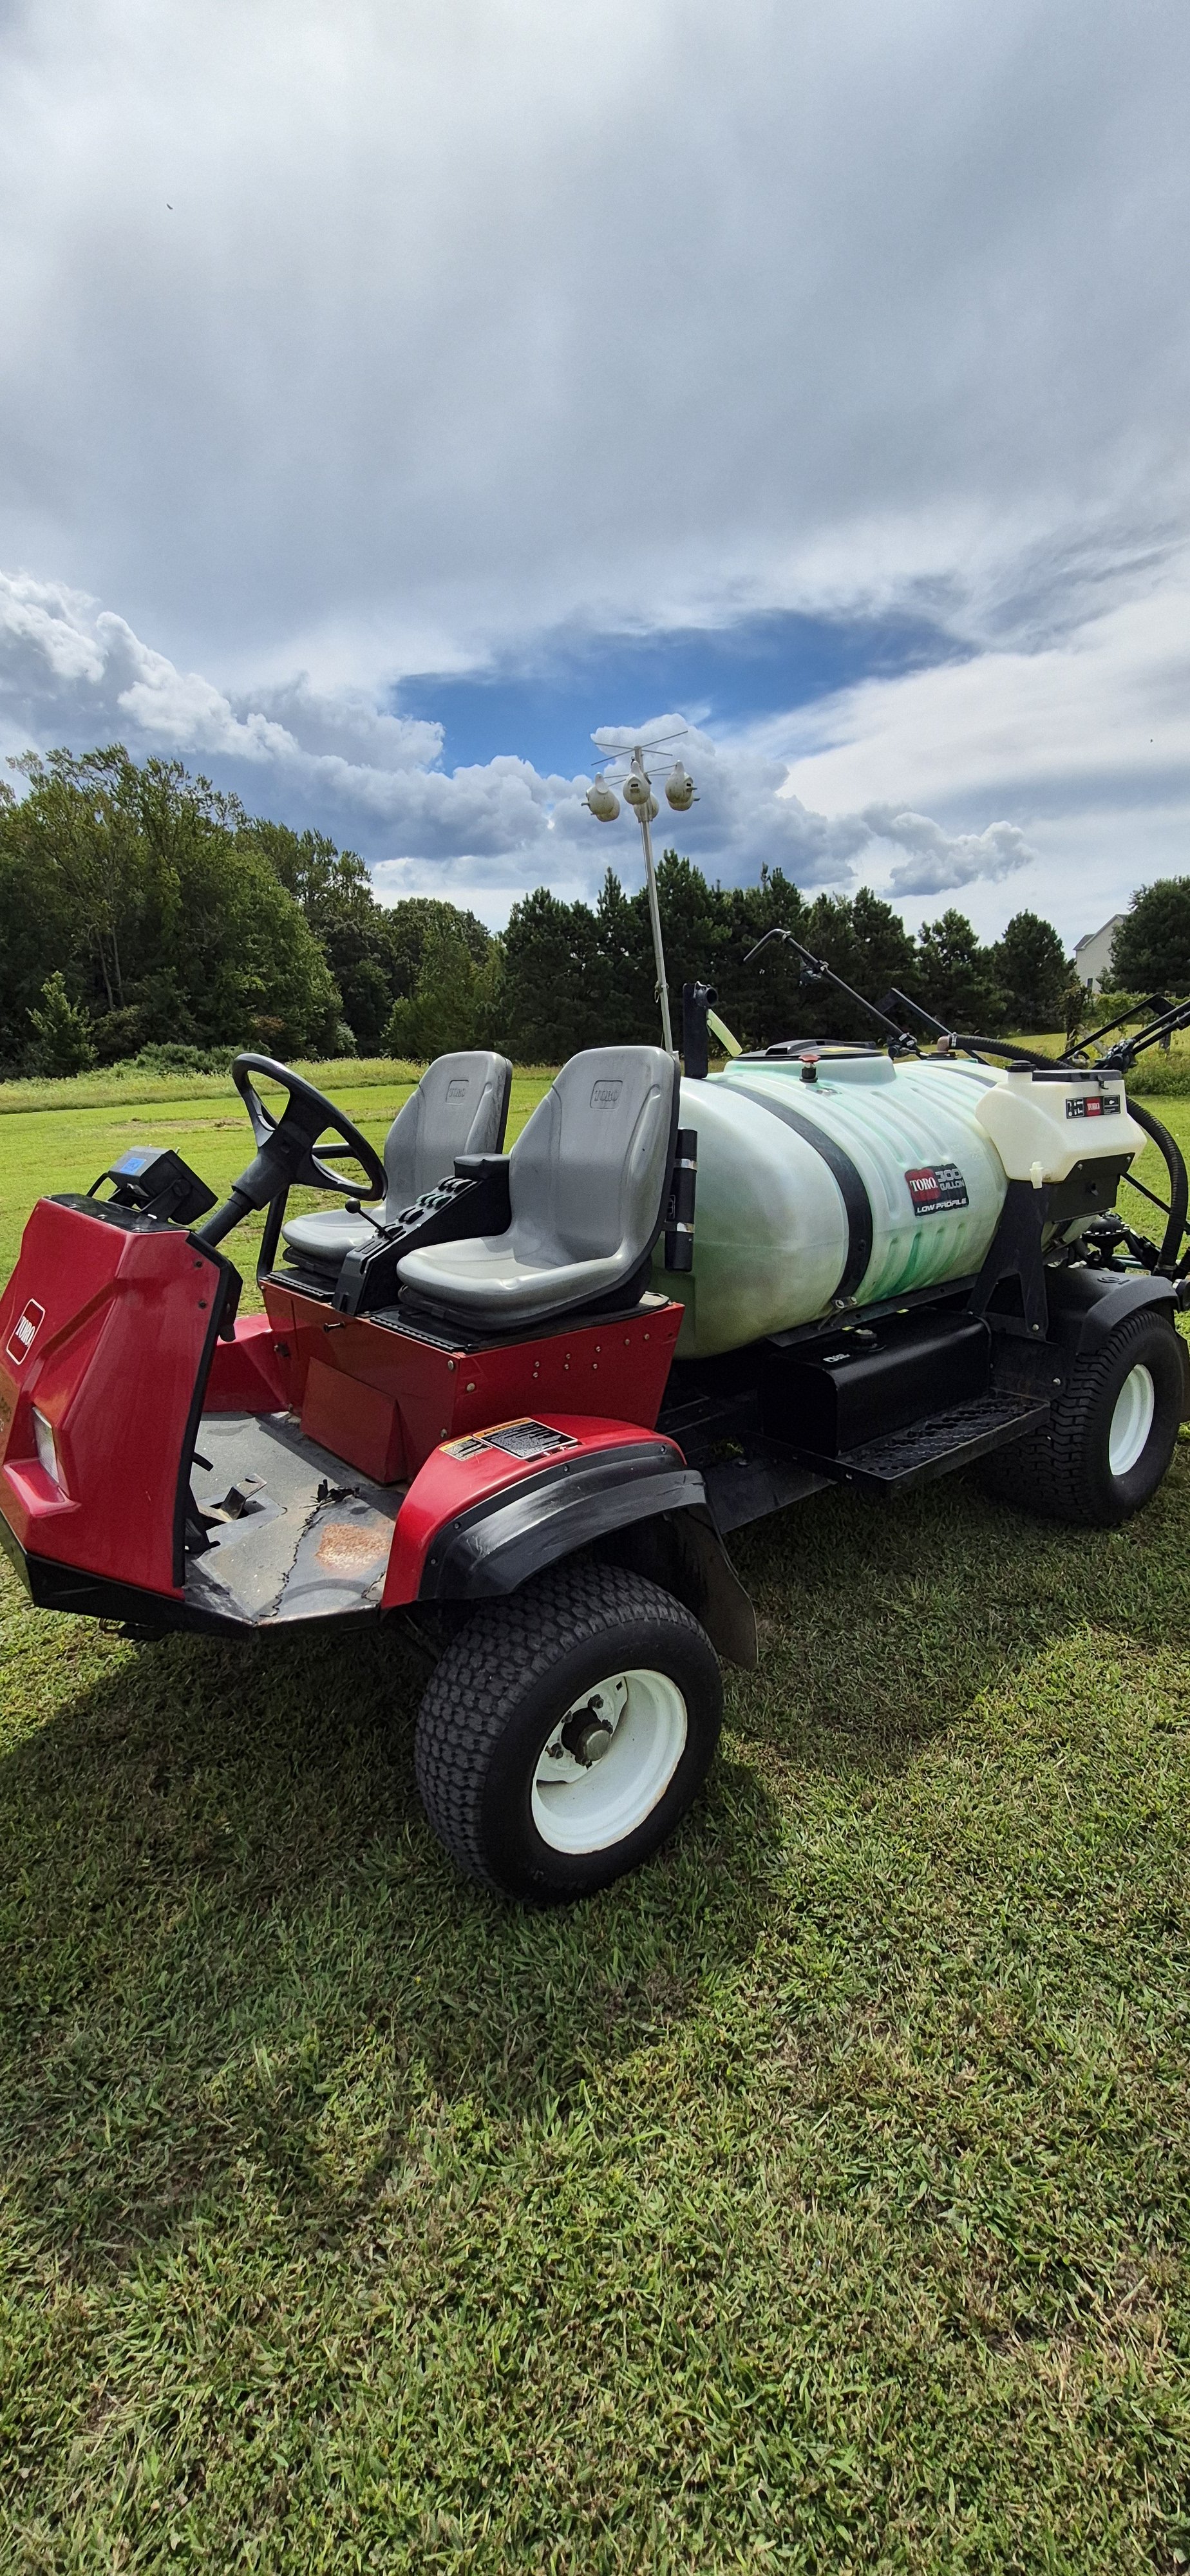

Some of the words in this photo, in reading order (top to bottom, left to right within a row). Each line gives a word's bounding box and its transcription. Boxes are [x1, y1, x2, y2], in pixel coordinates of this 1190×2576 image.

[935, 1168, 962, 1183] 300
[909, 1177, 937, 1191] TORO
[940, 1179, 965, 1191] GALLON
[917, 1204, 935, 1213] LOW
[936, 1198, 967, 1209] PROFILE
[15, 1316, 36, 1346] TORO
